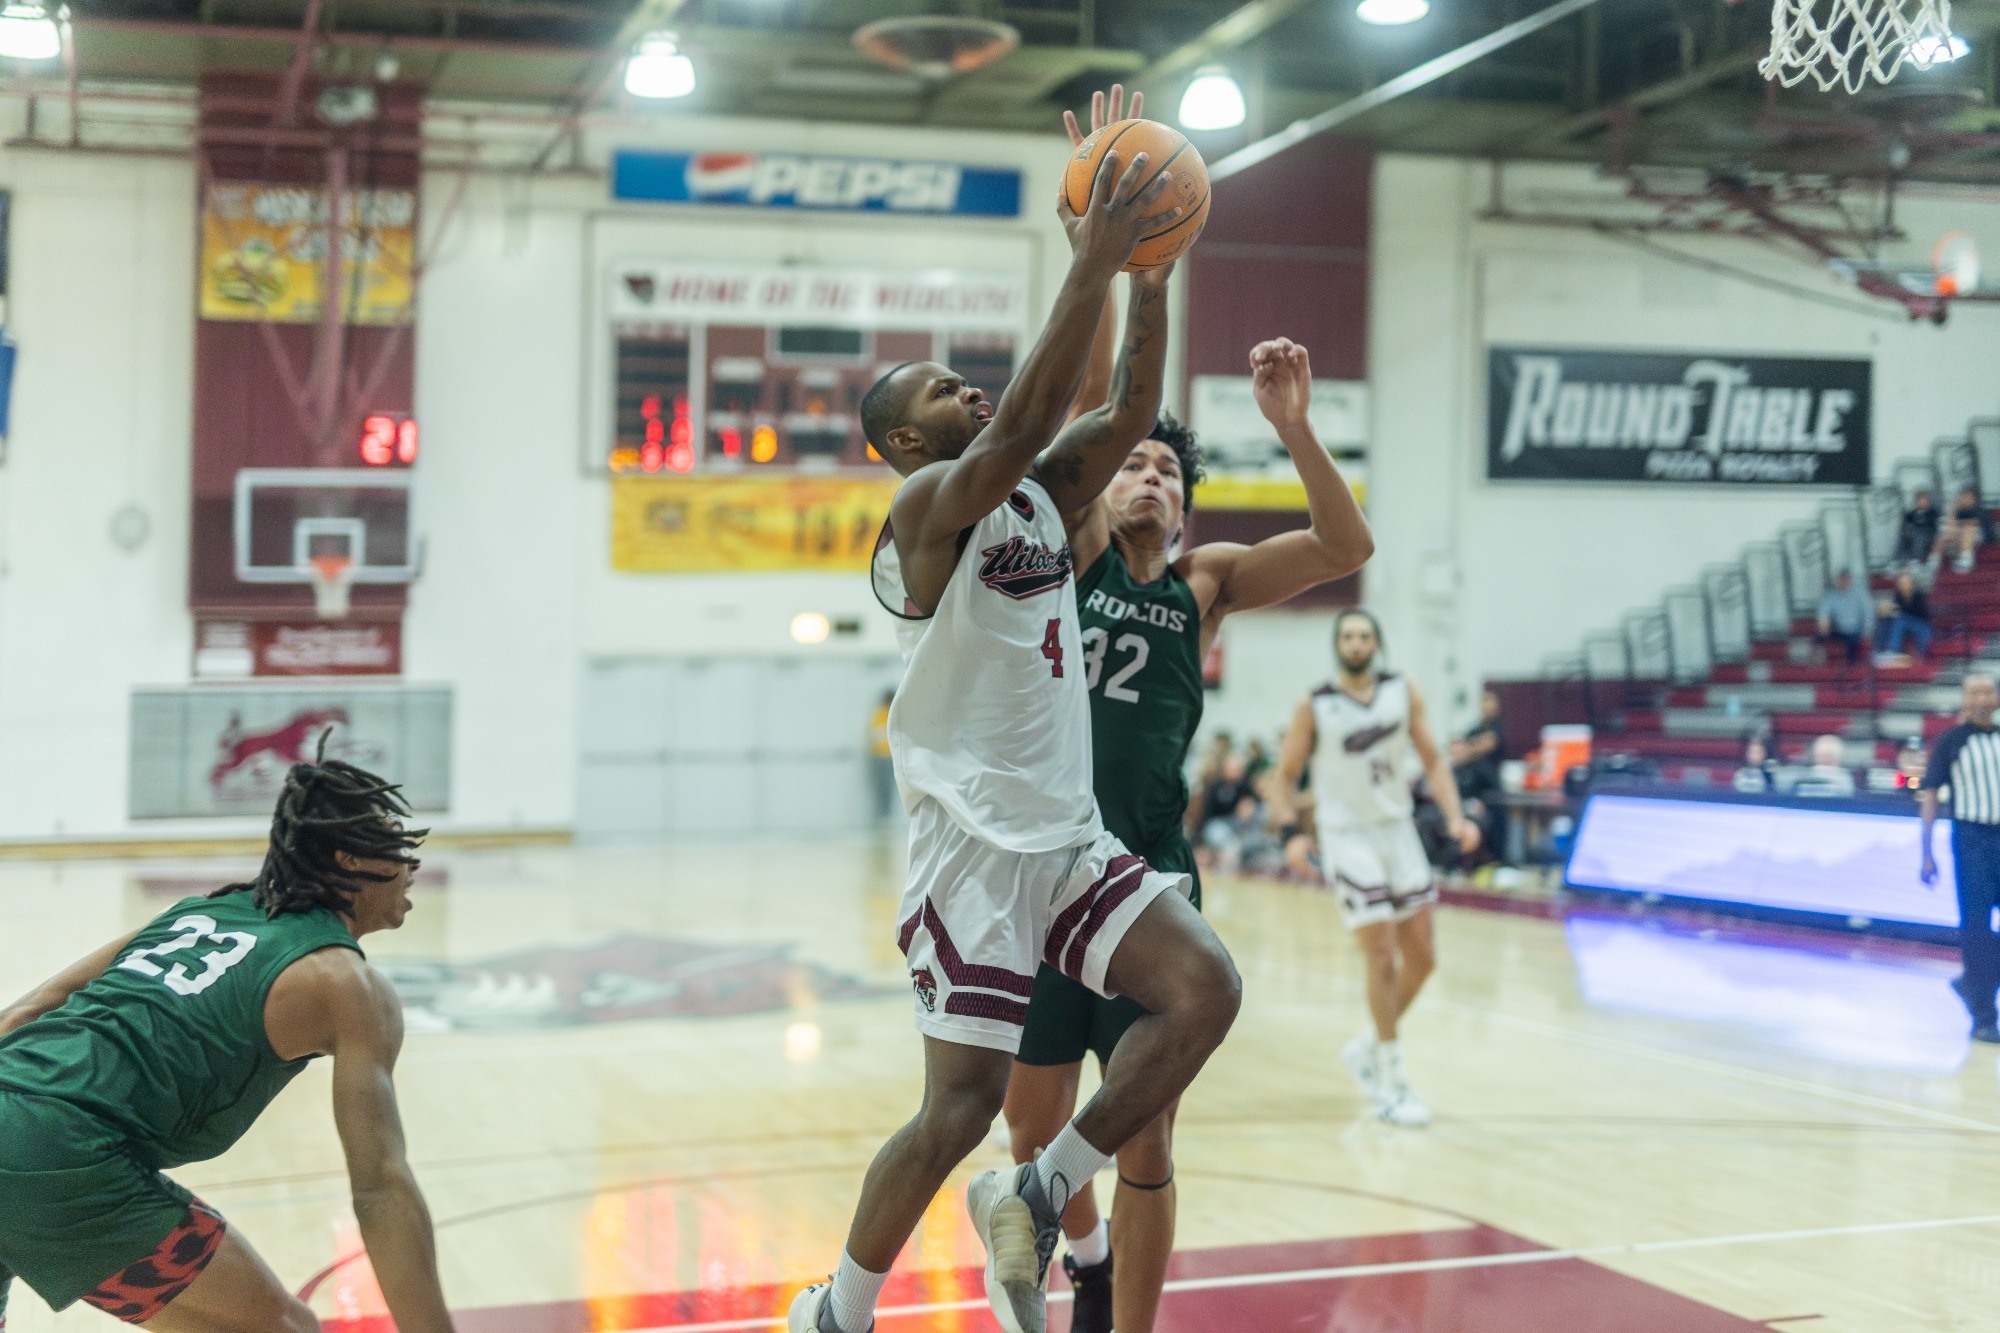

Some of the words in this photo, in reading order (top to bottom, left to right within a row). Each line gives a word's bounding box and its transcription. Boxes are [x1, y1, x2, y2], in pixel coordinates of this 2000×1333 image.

[750, 157, 963, 210] PEPSI
[361, 416, 418, 465] 21
[1040, 618, 1063, 678] 4
[1081, 626, 1150, 704] 32
[117, 915, 258, 995] 23
